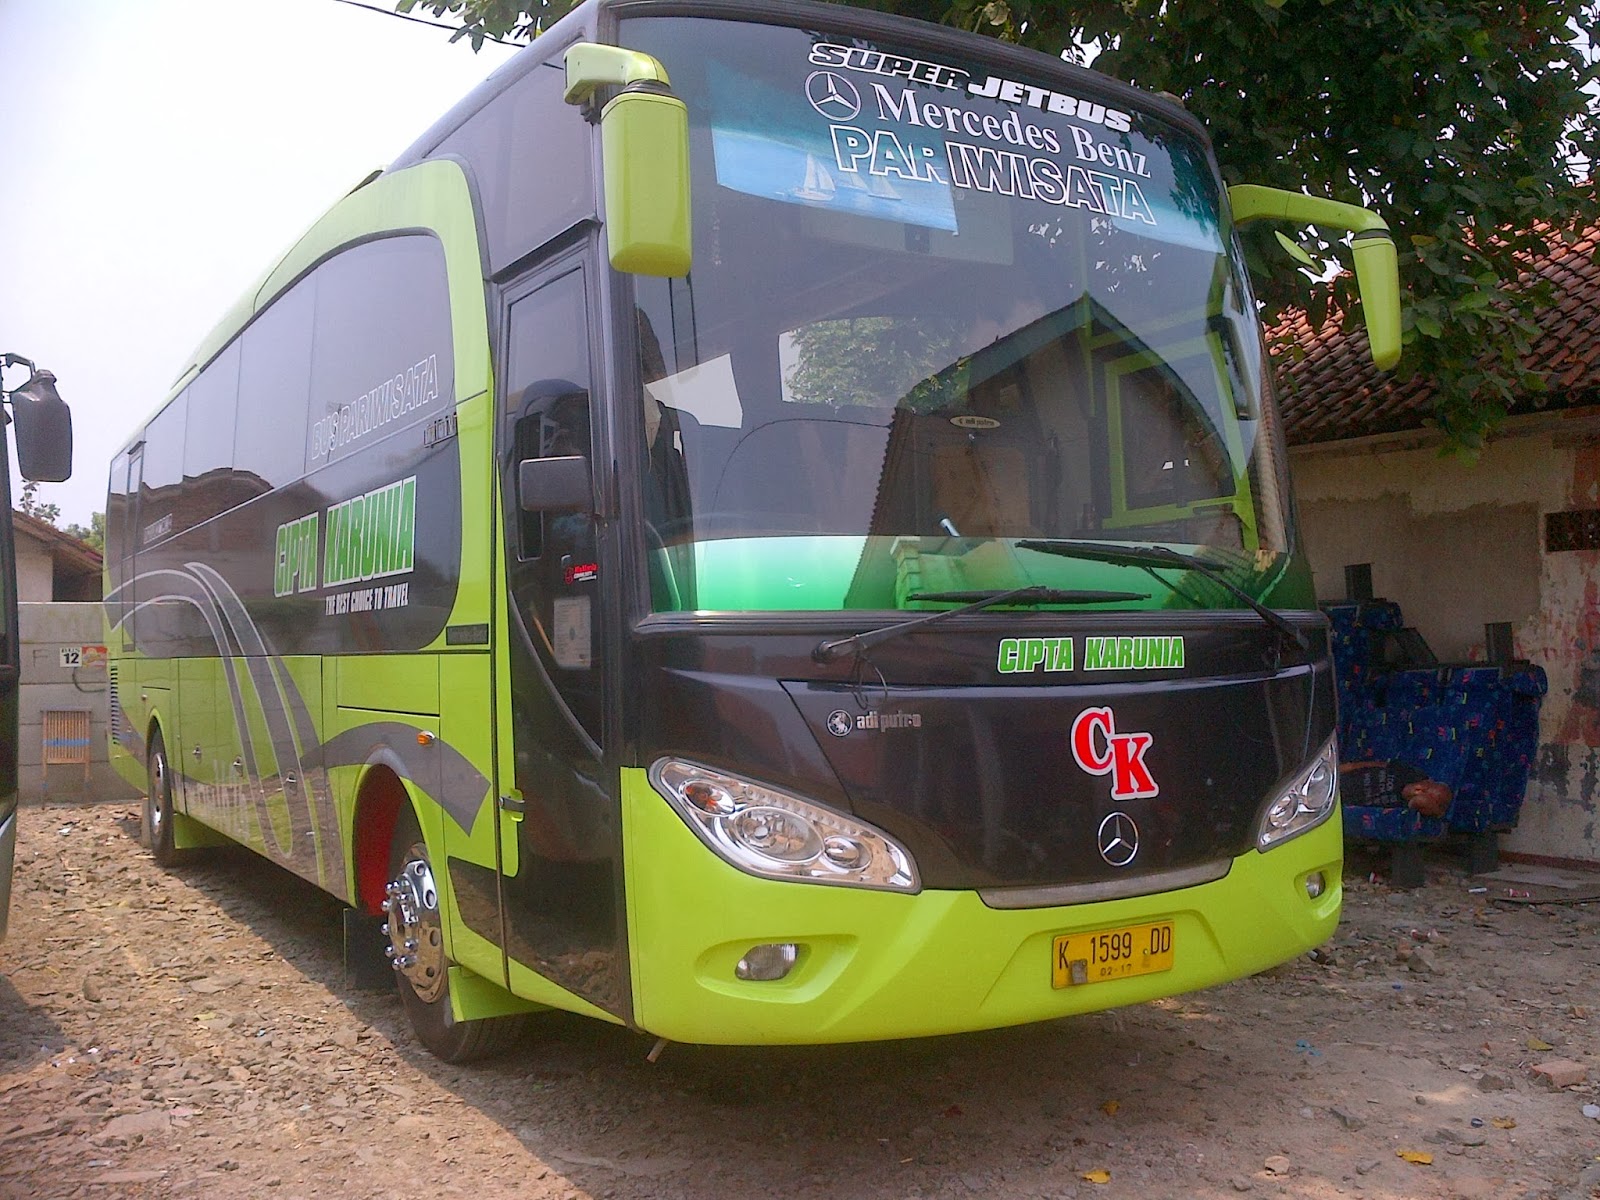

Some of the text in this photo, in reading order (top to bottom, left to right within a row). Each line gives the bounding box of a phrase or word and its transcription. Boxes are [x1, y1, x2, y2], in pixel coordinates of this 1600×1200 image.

[808, 42, 1132, 133] SUPER JETBUS
[869, 81, 1152, 179] Mercedes Benz
[829, 123, 1158, 226] PARIWISATA
[311, 411, 340, 460] BUS
[339, 353, 439, 447] PARIWISATA
[274, 475, 417, 598] CIPTA KARUNIA
[326, 581, 408, 615] THE BEST CHOICE TO TRAVEL
[64, 652, 79, 663] 12
[997, 635, 1185, 673] CIPTA KARUNIA
[856, 710, 922, 733] adi putra
[1070, 706, 1159, 801] CK
[1059, 926, 1171, 970] K 1599 DD
